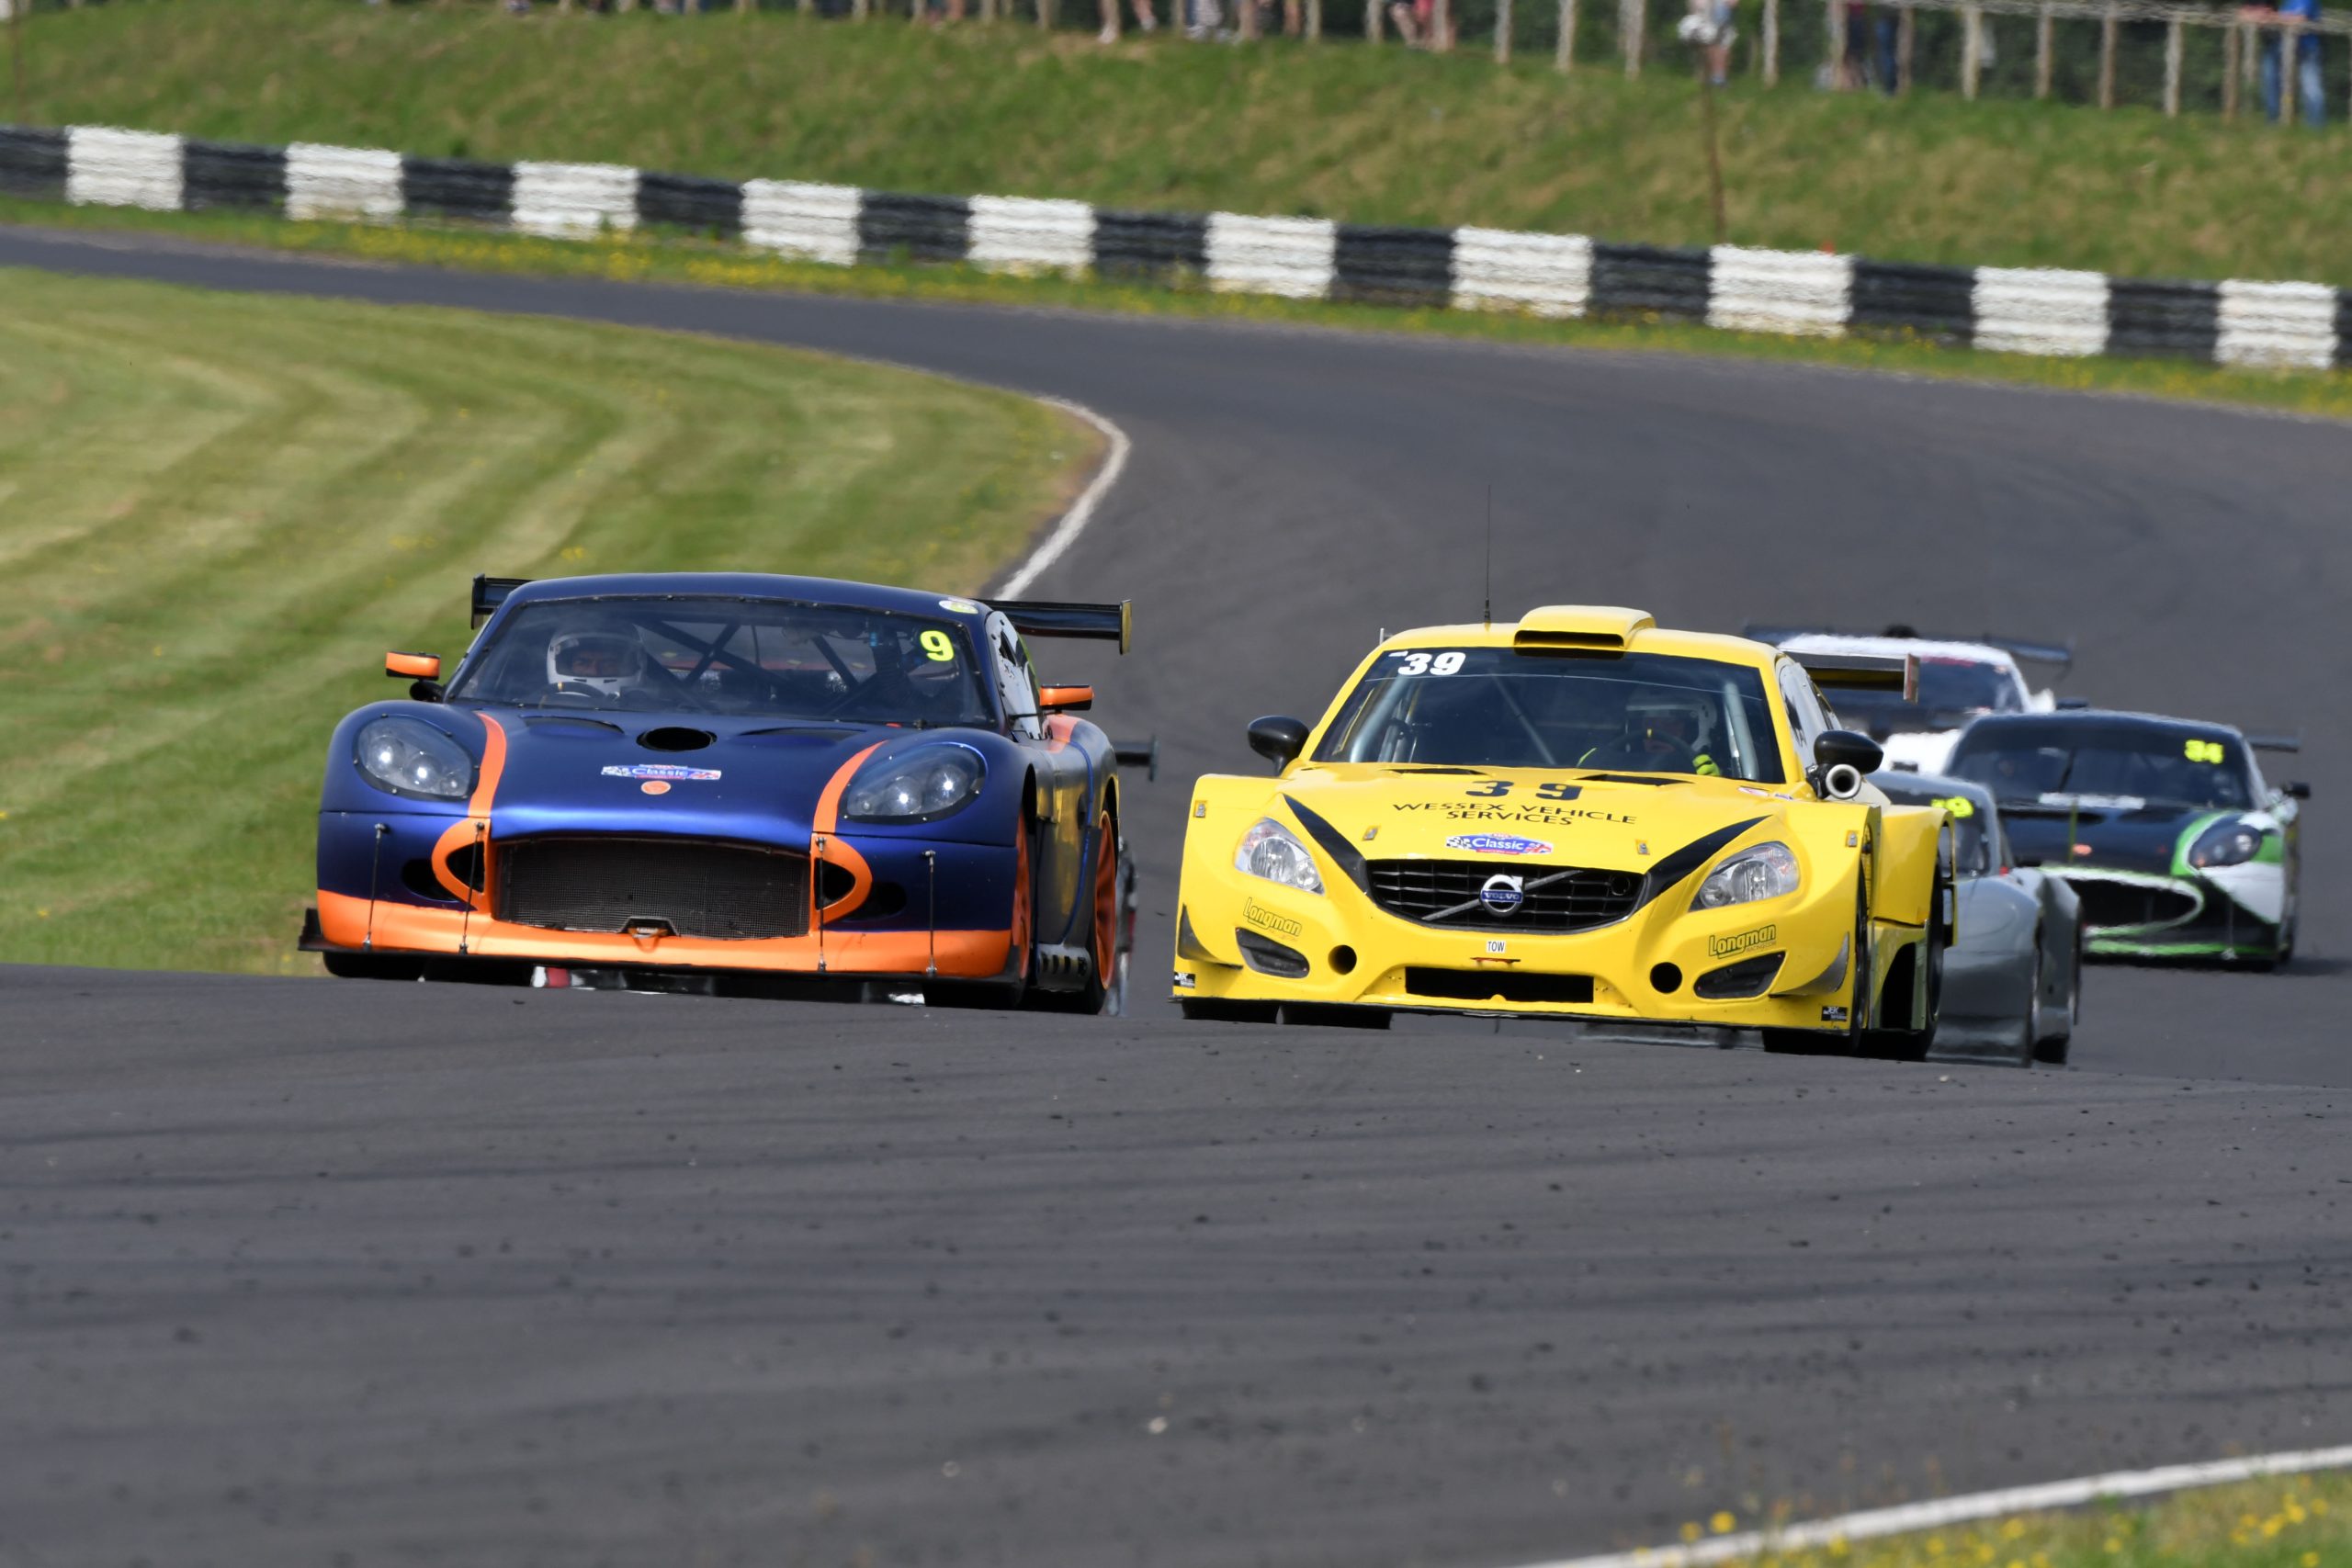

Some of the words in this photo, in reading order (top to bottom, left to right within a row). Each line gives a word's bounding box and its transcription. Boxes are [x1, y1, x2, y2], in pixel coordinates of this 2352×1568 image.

[920, 630, 954, 661] 9
[1397, 651, 1466, 676] 39
[1393, 802, 1506, 812] WESSEX
[1521, 805, 1638, 825] VEHICLE
[1446, 810, 1573, 826] SERVICES
[1472, 837, 1524, 851] Classic
[1484, 892, 1520, 900] VOLVO
[1243, 897, 1303, 937] Longman
[1487, 941, 1505, 953] TOW
[1709, 924, 1776, 959] Longman
